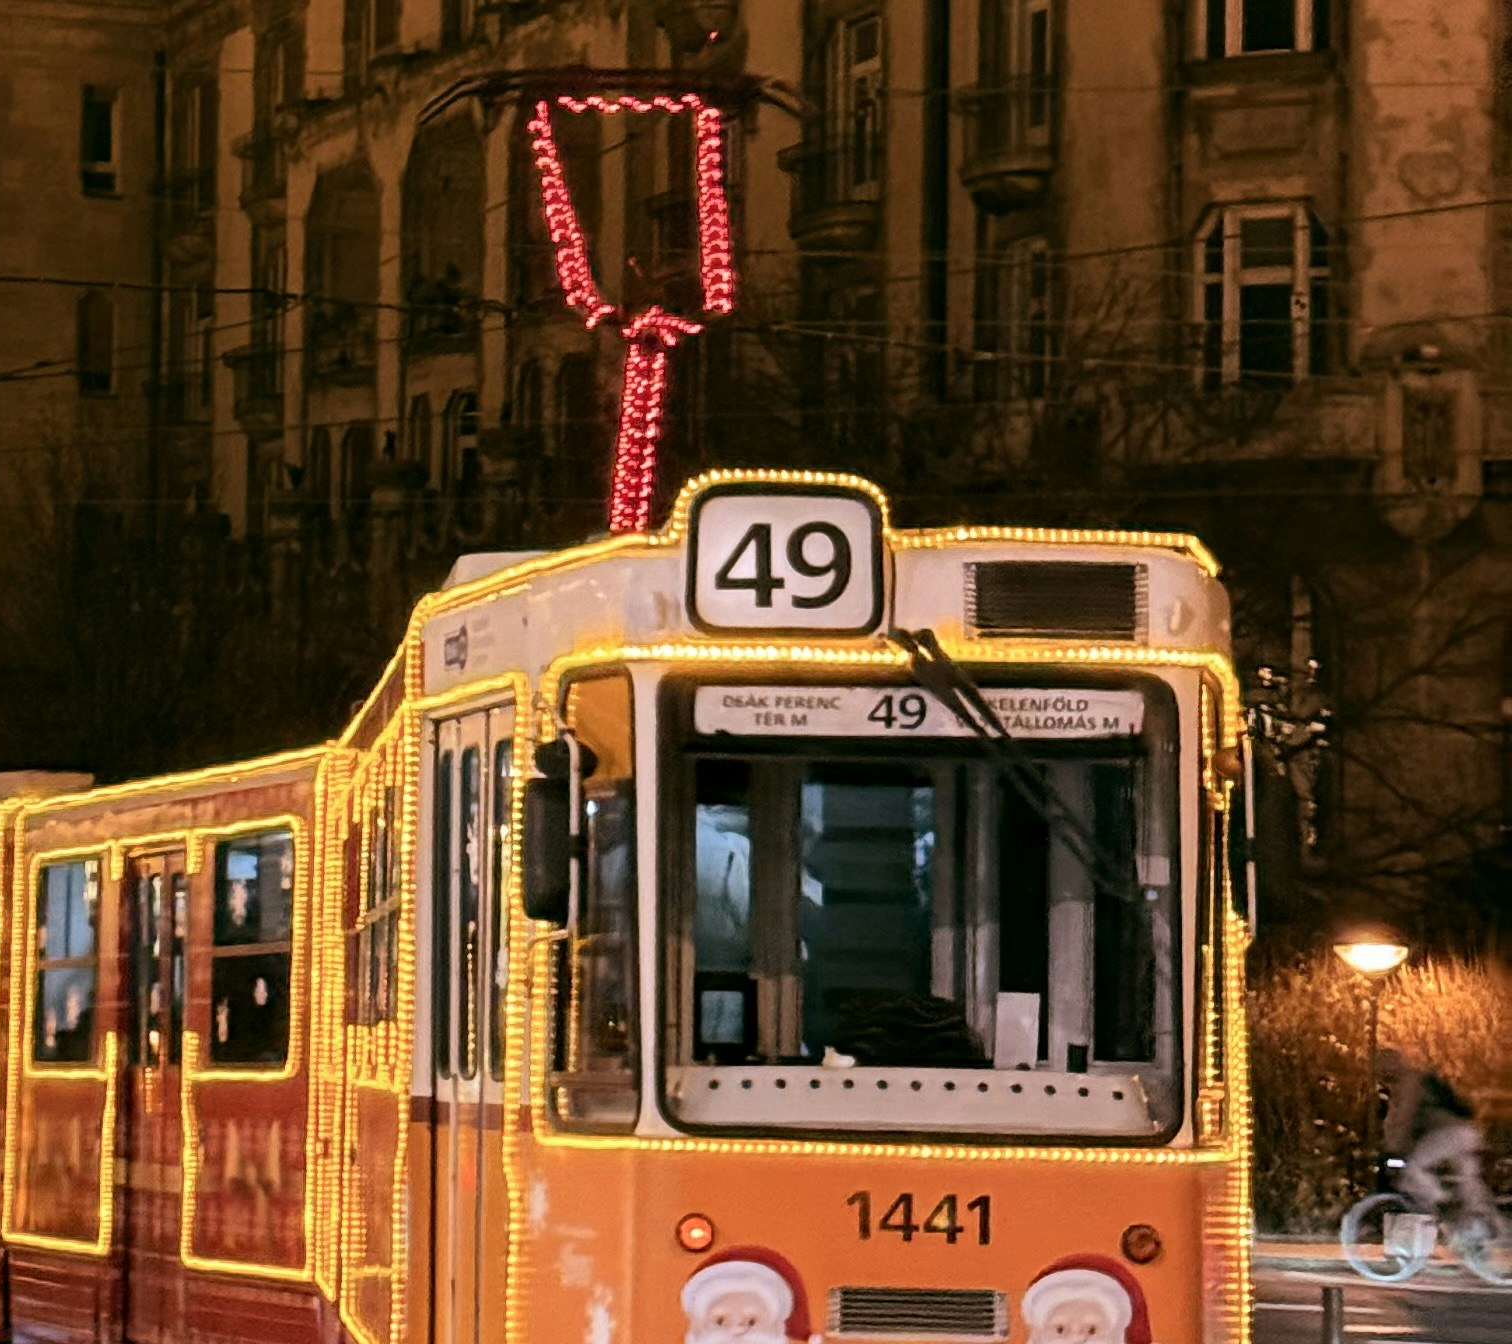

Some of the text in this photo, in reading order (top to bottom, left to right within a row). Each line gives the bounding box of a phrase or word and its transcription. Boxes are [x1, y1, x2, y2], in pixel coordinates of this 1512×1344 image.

[715, 521, 852, 609] 49
[722, 693, 841, 710] DEÁK FERENC
[867, 694, 927, 731] 49
[753, 711, 808, 727] TÉR M
[1103, 716, 1120, 730] M
[846, 1190, 991, 1246] 1441
